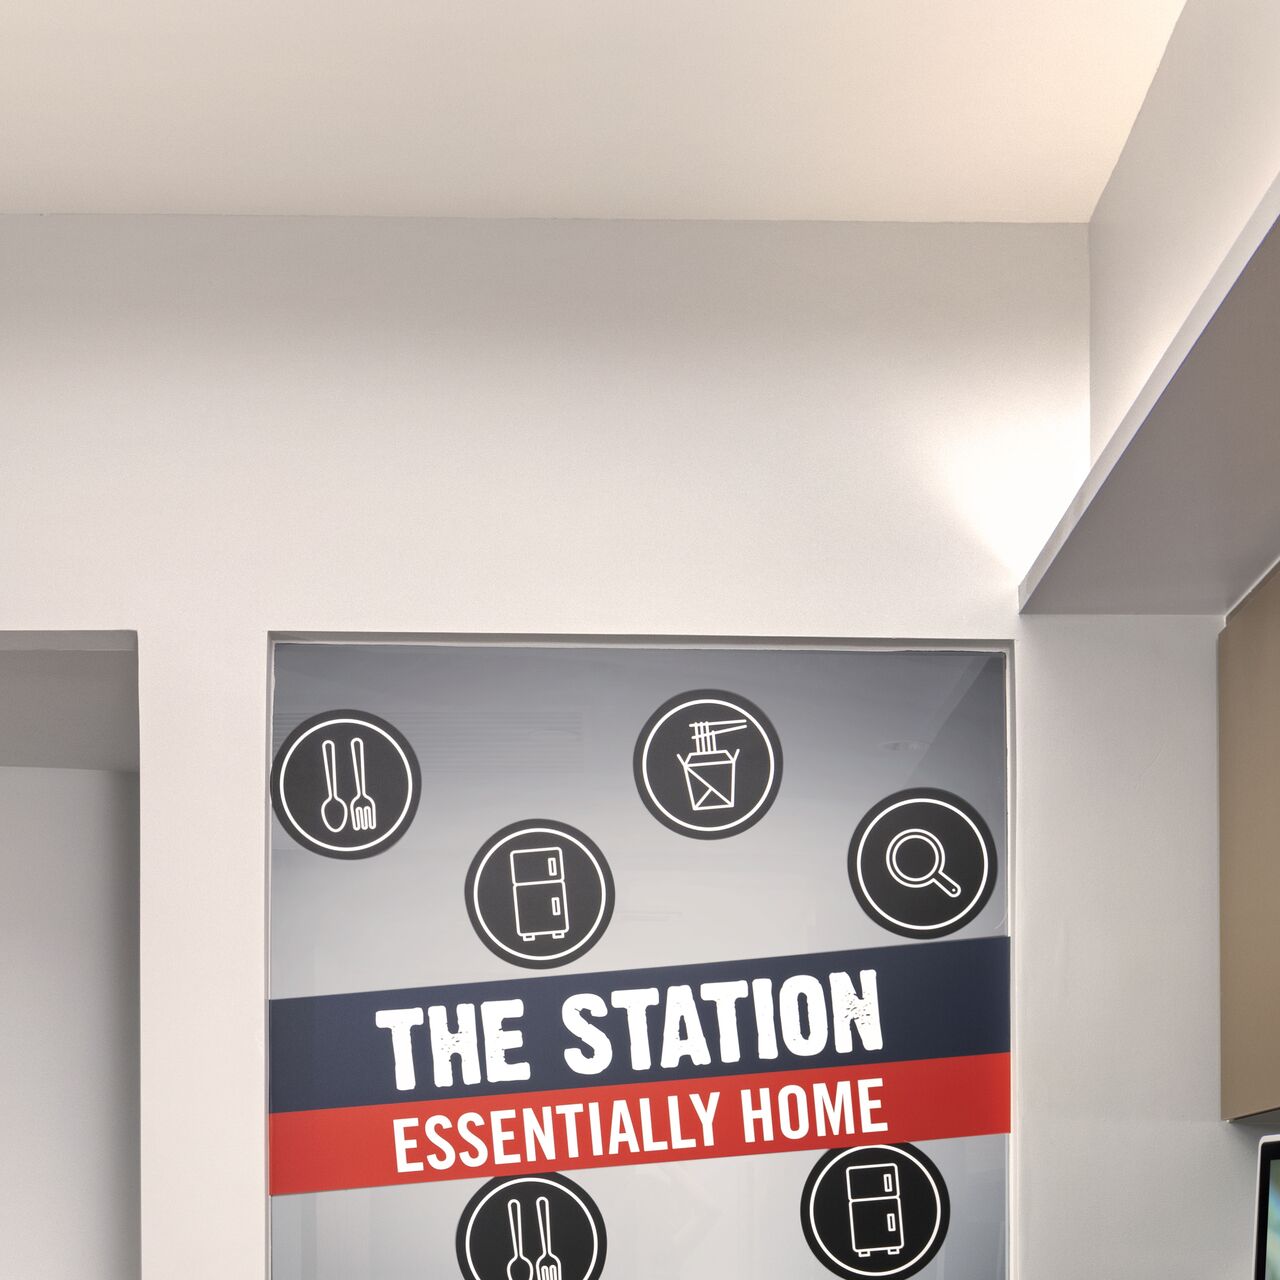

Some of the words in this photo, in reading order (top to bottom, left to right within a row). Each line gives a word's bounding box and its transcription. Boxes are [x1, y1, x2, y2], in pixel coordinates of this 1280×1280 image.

[376, 999, 531, 1091] THE
[562, 969, 884, 1075] STATION
[393, 1092, 721, 1173] ESSENTIALLY
[740, 1078, 889, 1143] HOME
